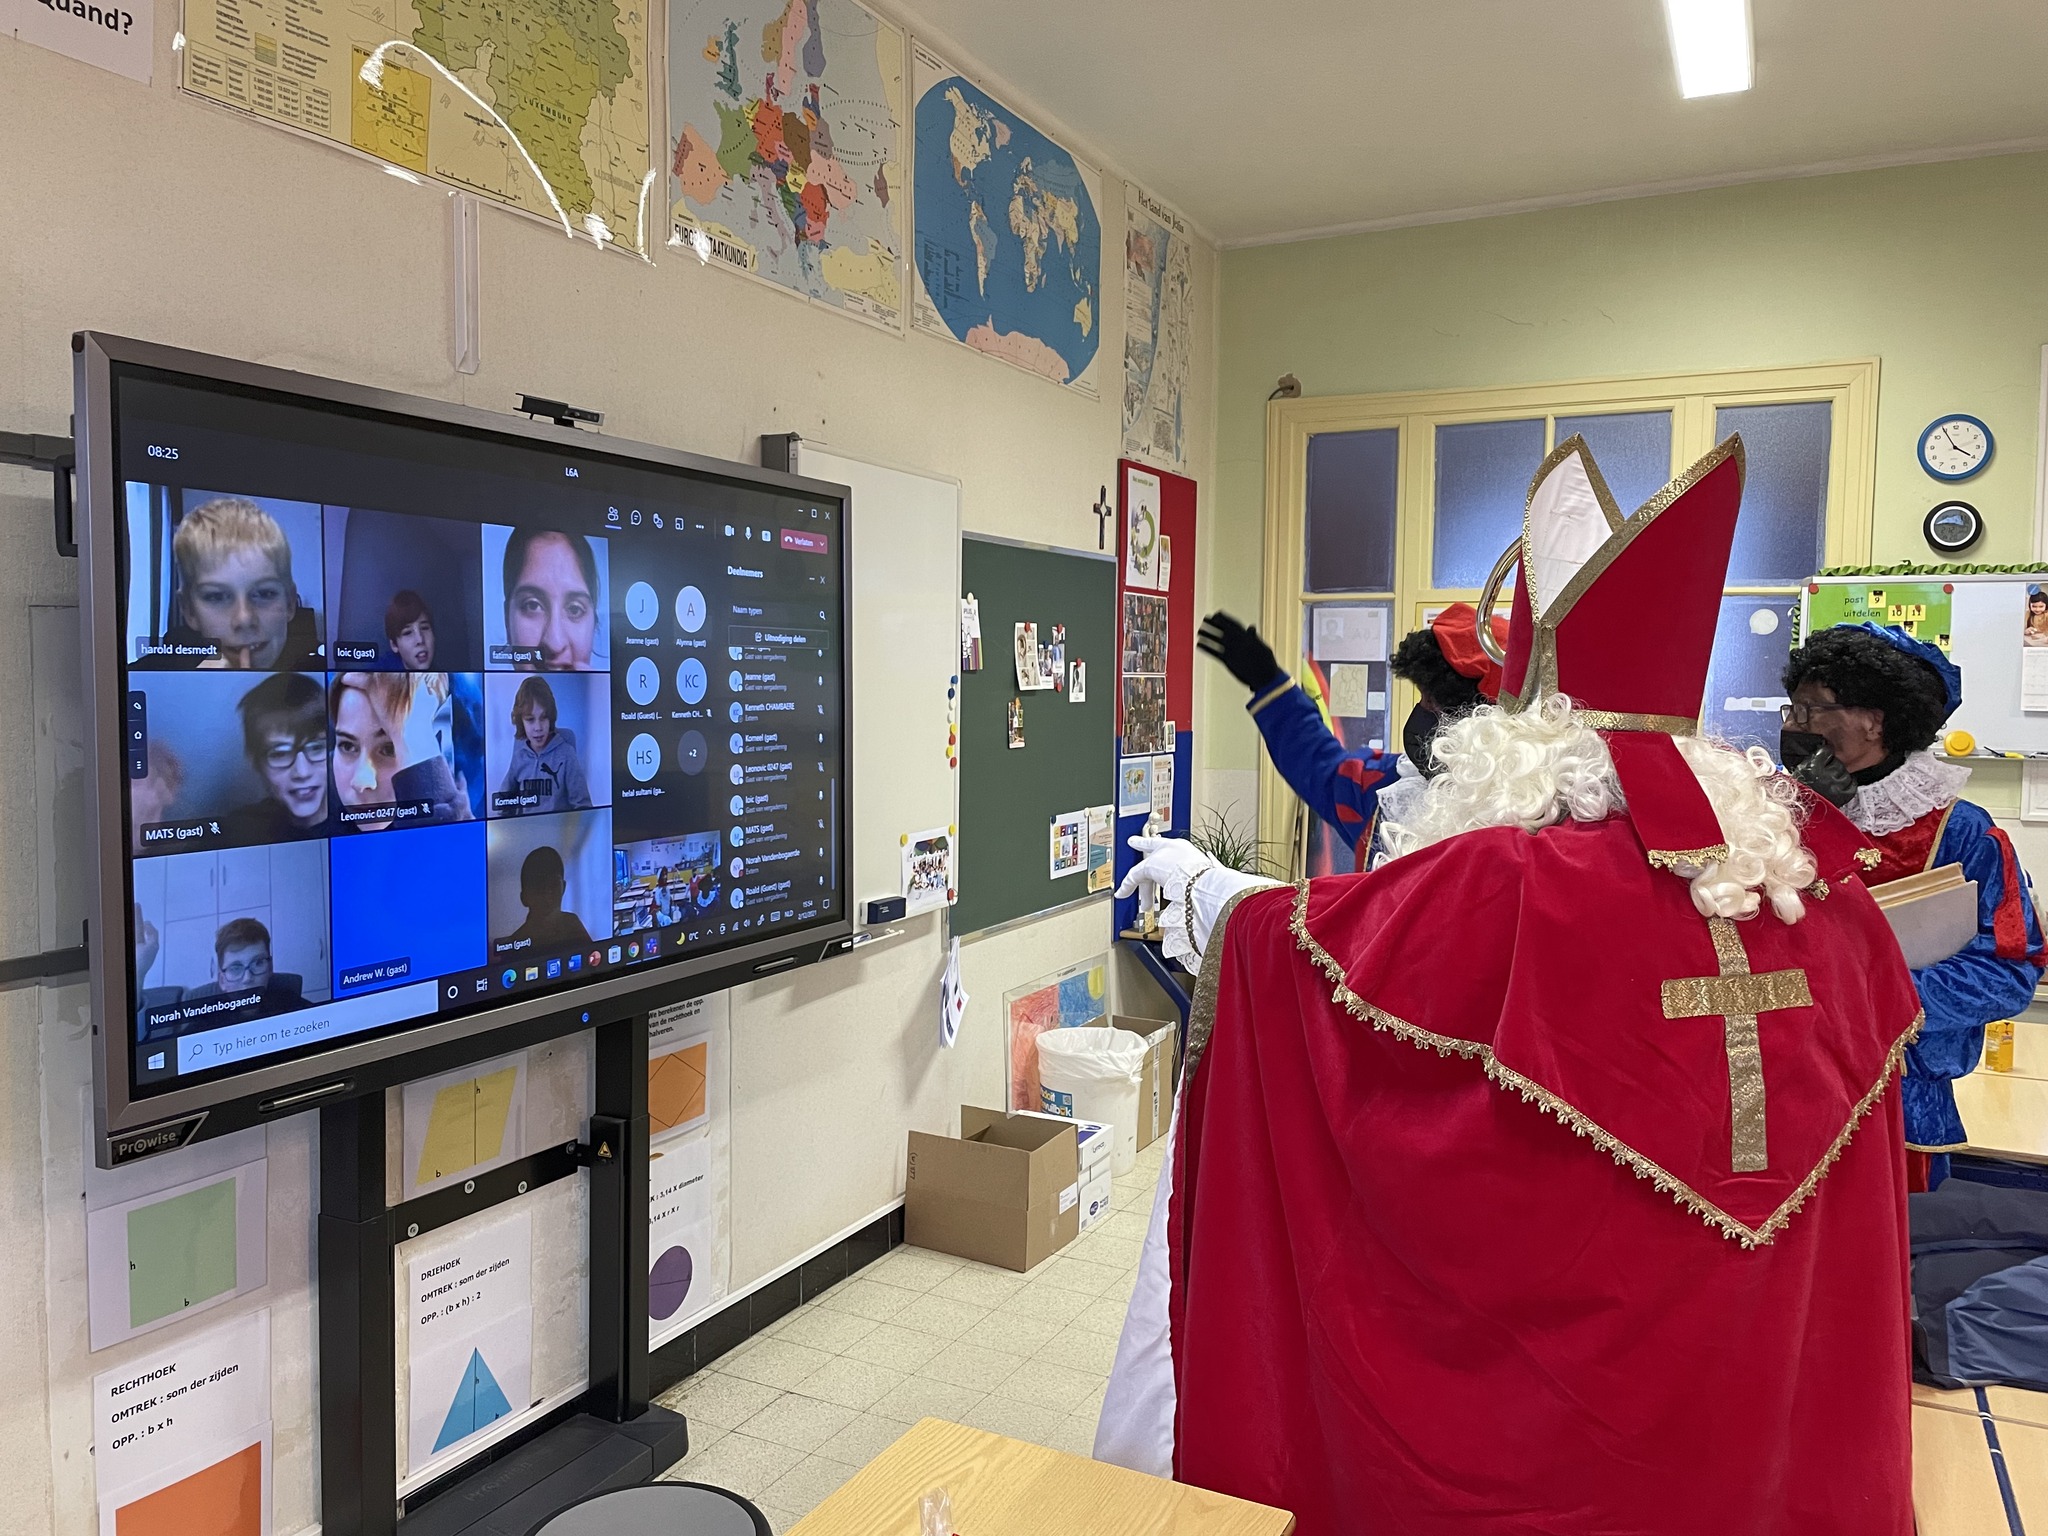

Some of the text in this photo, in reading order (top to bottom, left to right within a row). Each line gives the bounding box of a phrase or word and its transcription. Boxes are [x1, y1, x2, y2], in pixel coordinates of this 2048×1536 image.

[38, 0, 133, 35] uand?
[524, 96, 572, 124] LUXEMBURG
[706, 235, 748, 269] TAATKUNDIG
[148, 444, 179, 461] 08:25
[565, 466, 579, 478] L6A
[795, 536, 814, 547] Verlaten
[727, 565, 764, 579] Deelnemers
[639, 599, 645, 613] J
[1844, 597, 1864, 605] post
[1874, 596, 1880, 604] 9
[687, 603, 696, 617] A
[732, 605, 763, 616] Naam typen
[1843, 610, 1881, 618] uitdelen
[1891, 609, 1902, 617] 10
[1911, 609, 1921, 617] 11
[644, 637, 659, 647] (gast)
[692, 639, 707, 649] (gast)
[764, 633, 807, 644] Uitnodiging delen
[1939, 638, 1949, 646] 13
[141, 644, 218, 656] harold desmedt
[353, 648, 376, 660] (gast)
[492, 650, 532, 661] fatima (gast)
[639, 674, 647, 689] R
[684, 674, 700, 689] KC
[671, 710, 692, 719] Kenneth
[744, 703, 765, 712] Kenneth
[636, 750, 653, 765] HS
[688, 749, 697, 758] +2
[494, 794, 538, 806] Korneel (gast)
[340, 805, 418, 822] Leonovic 0247 (gast)
[145, 825, 204, 841] MATS (gast)
[745, 825, 760, 834] MATS
[745, 854, 762, 865] Norah
[784, 910, 794, 918] NLD
[496, 937, 532, 952] Iman (gast)
[343, 963, 408, 986] Andrew W. (gast)
[150, 993, 262, 1026] Norah Vandenbogaerde
[657, 1003, 686, 1017] berekenen
[686, 1001, 693, 1009] de
[648, 1020, 660, 1029] van
[660, 1018, 667, 1026] de
[667, 1009, 694, 1023] rechthoek
[213, 1018, 330, 1057] Typ hier om te zoeken
[678, 1174, 704, 1190] diameter
[129, 1261, 136, 1271] h
[421, 1257, 461, 1282] DRIEHOEK
[420, 1258, 510, 1303] OMTREK som der zijden
[184, 1297, 190, 1307] b
[420, 1311, 439, 1325] OPP.
[445, 1304, 454, 1315] (b
[461, 1296, 470, 1307] h)
[110, 1362, 177, 1398] RECHTHOEK
[111, 1363, 239, 1424] OMTREK som der zijden
[112, 1417, 173, 1450] OPP. b x h
